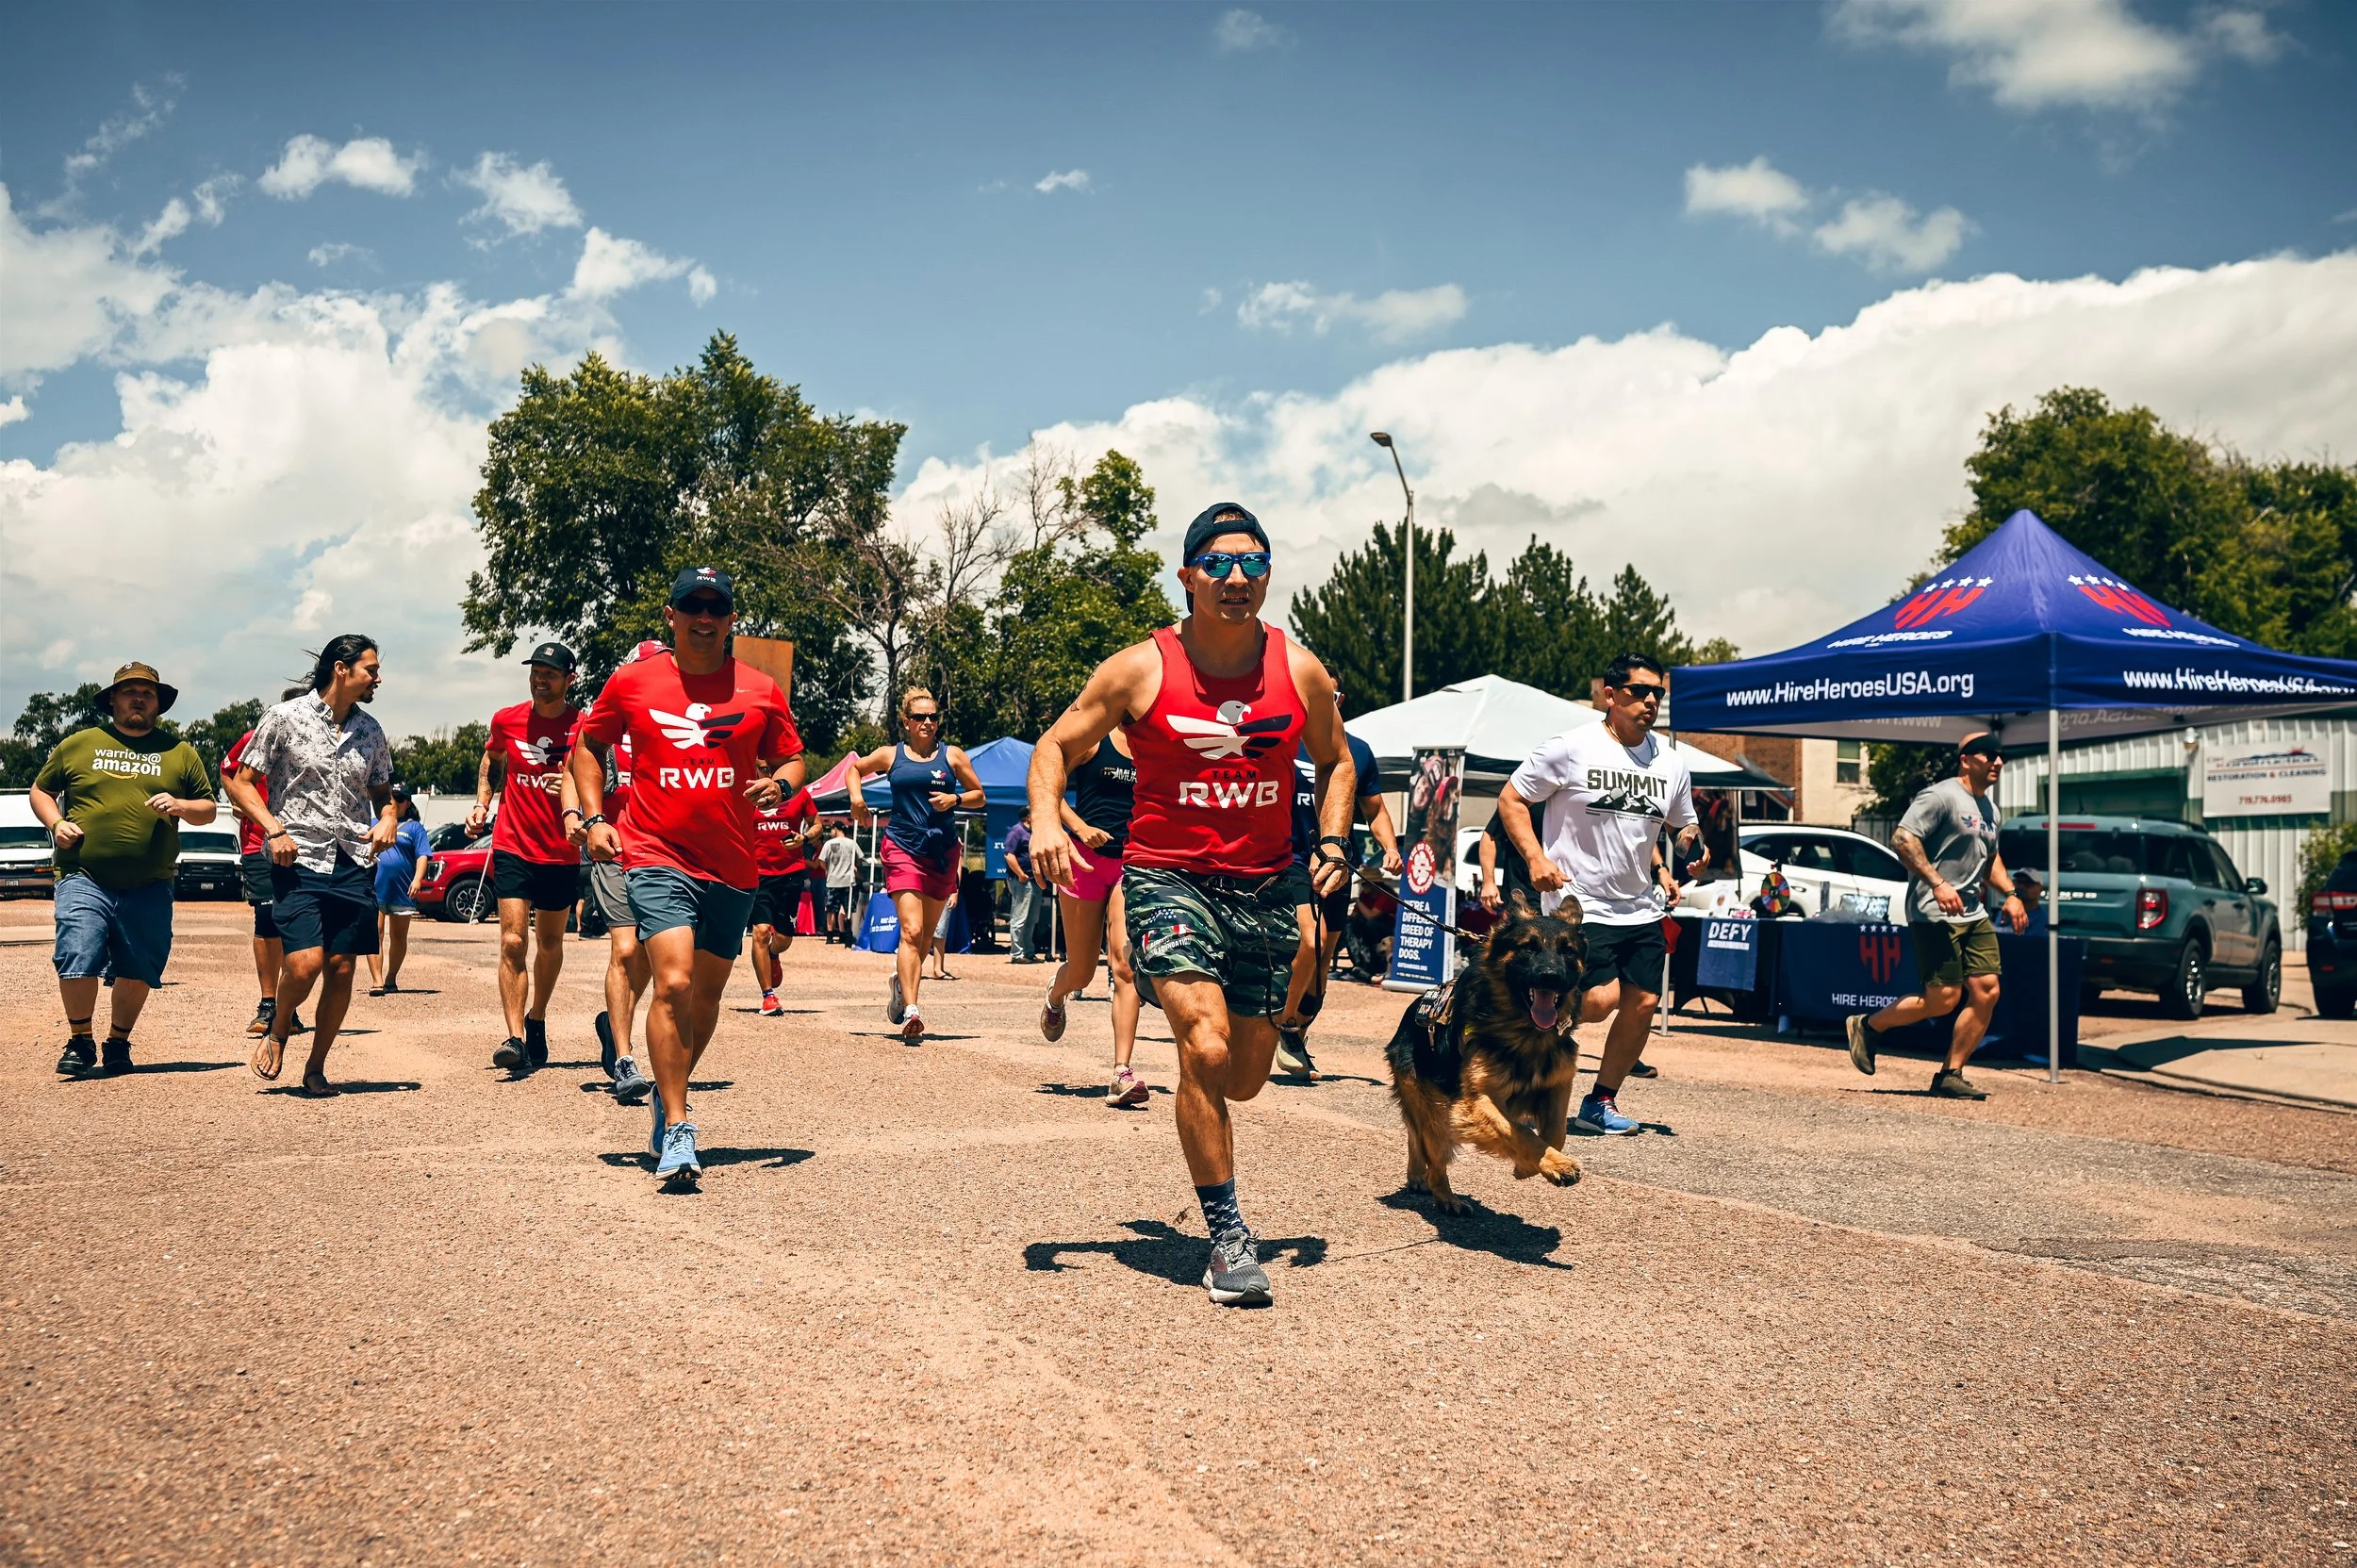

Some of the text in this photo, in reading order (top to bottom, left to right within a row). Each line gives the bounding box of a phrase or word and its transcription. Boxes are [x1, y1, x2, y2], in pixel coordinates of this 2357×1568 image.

[1726, 670, 1974, 707] www.HireHeroesUSA.org
[94, 749, 161, 765] warriors@
[92, 758, 161, 776] amazon
[1212, 770, 1257, 779] TEAM
[517, 773, 549, 789] RW
[660, 767, 735, 789] RWB
[1587, 768, 1668, 801] SUMMIT
[1178, 781, 1279, 809] RWB
[757, 821, 790, 831] RWB
[1424, 901, 1430, 913] A
[1401, 924, 1434, 937] BREED OF
[1708, 921, 1752, 941] DEFY
[1400, 935, 1434, 949] THERAPY
[1398, 948, 1421, 961] DOGS.
[1832, 993, 1857, 1006] HIRE
